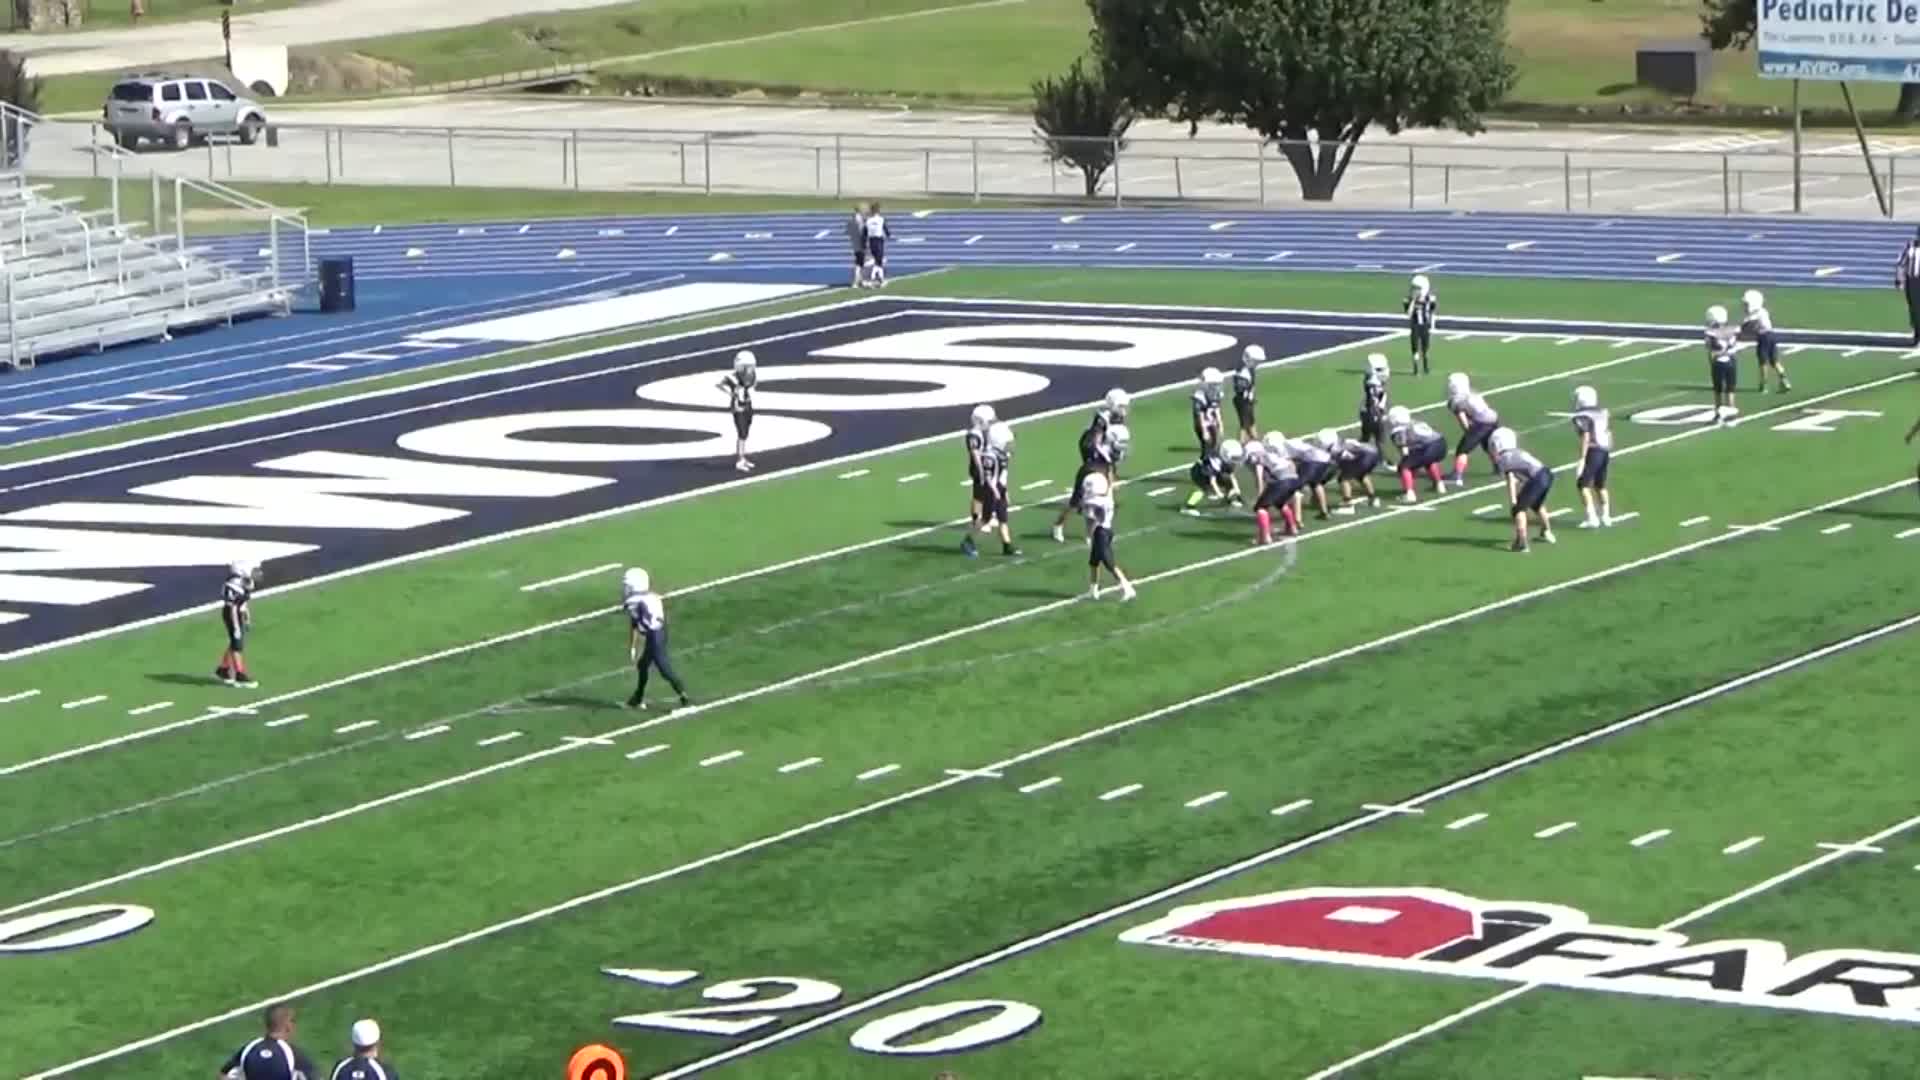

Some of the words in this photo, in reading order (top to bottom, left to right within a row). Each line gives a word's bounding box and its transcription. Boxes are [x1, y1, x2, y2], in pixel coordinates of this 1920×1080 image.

[1763, 0, 1877, 23] Pediatric
[1483, 930, 1920, 1010] FAR
[611, 976, 1043, 1056] 20
